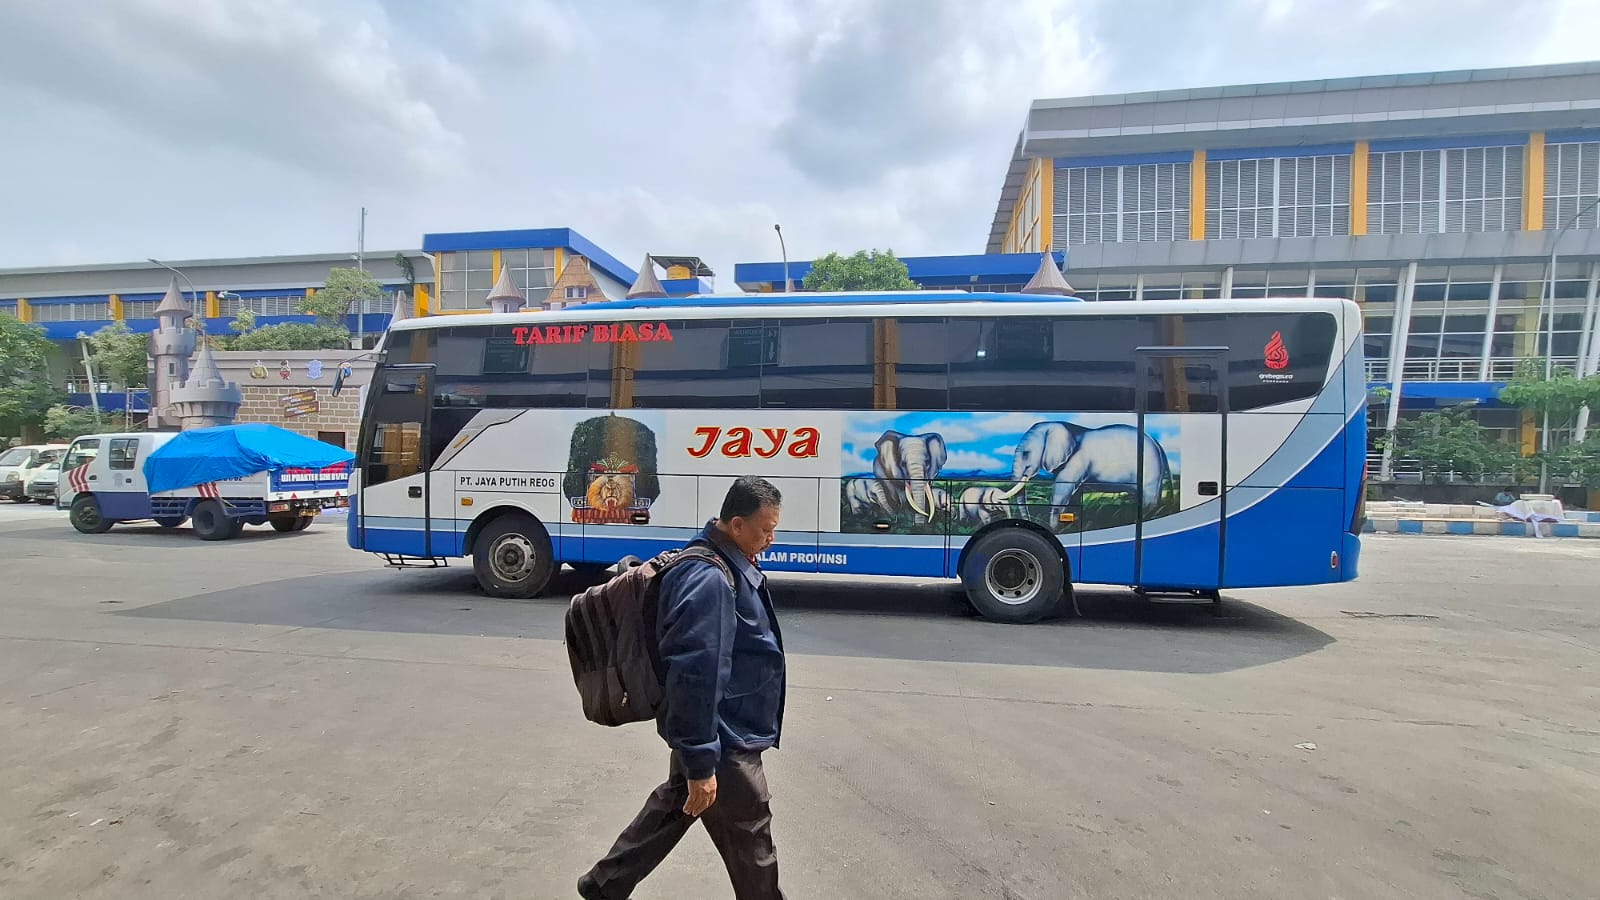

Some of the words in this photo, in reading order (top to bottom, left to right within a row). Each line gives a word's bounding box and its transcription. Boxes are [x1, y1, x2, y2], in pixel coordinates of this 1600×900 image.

[512, 325, 589, 345] TARIF
[592, 321, 673, 343] BIASA
[686, 425, 820, 459] Jaya
[460, 476, 473, 486] PT.
[475, 477, 497, 487] JAYA
[499, 477, 527, 487] PUTIH
[529, 478, 555, 488] REOG
[755, 551, 787, 563] ALAM
[790, 552, 847, 565] PROVINSI
